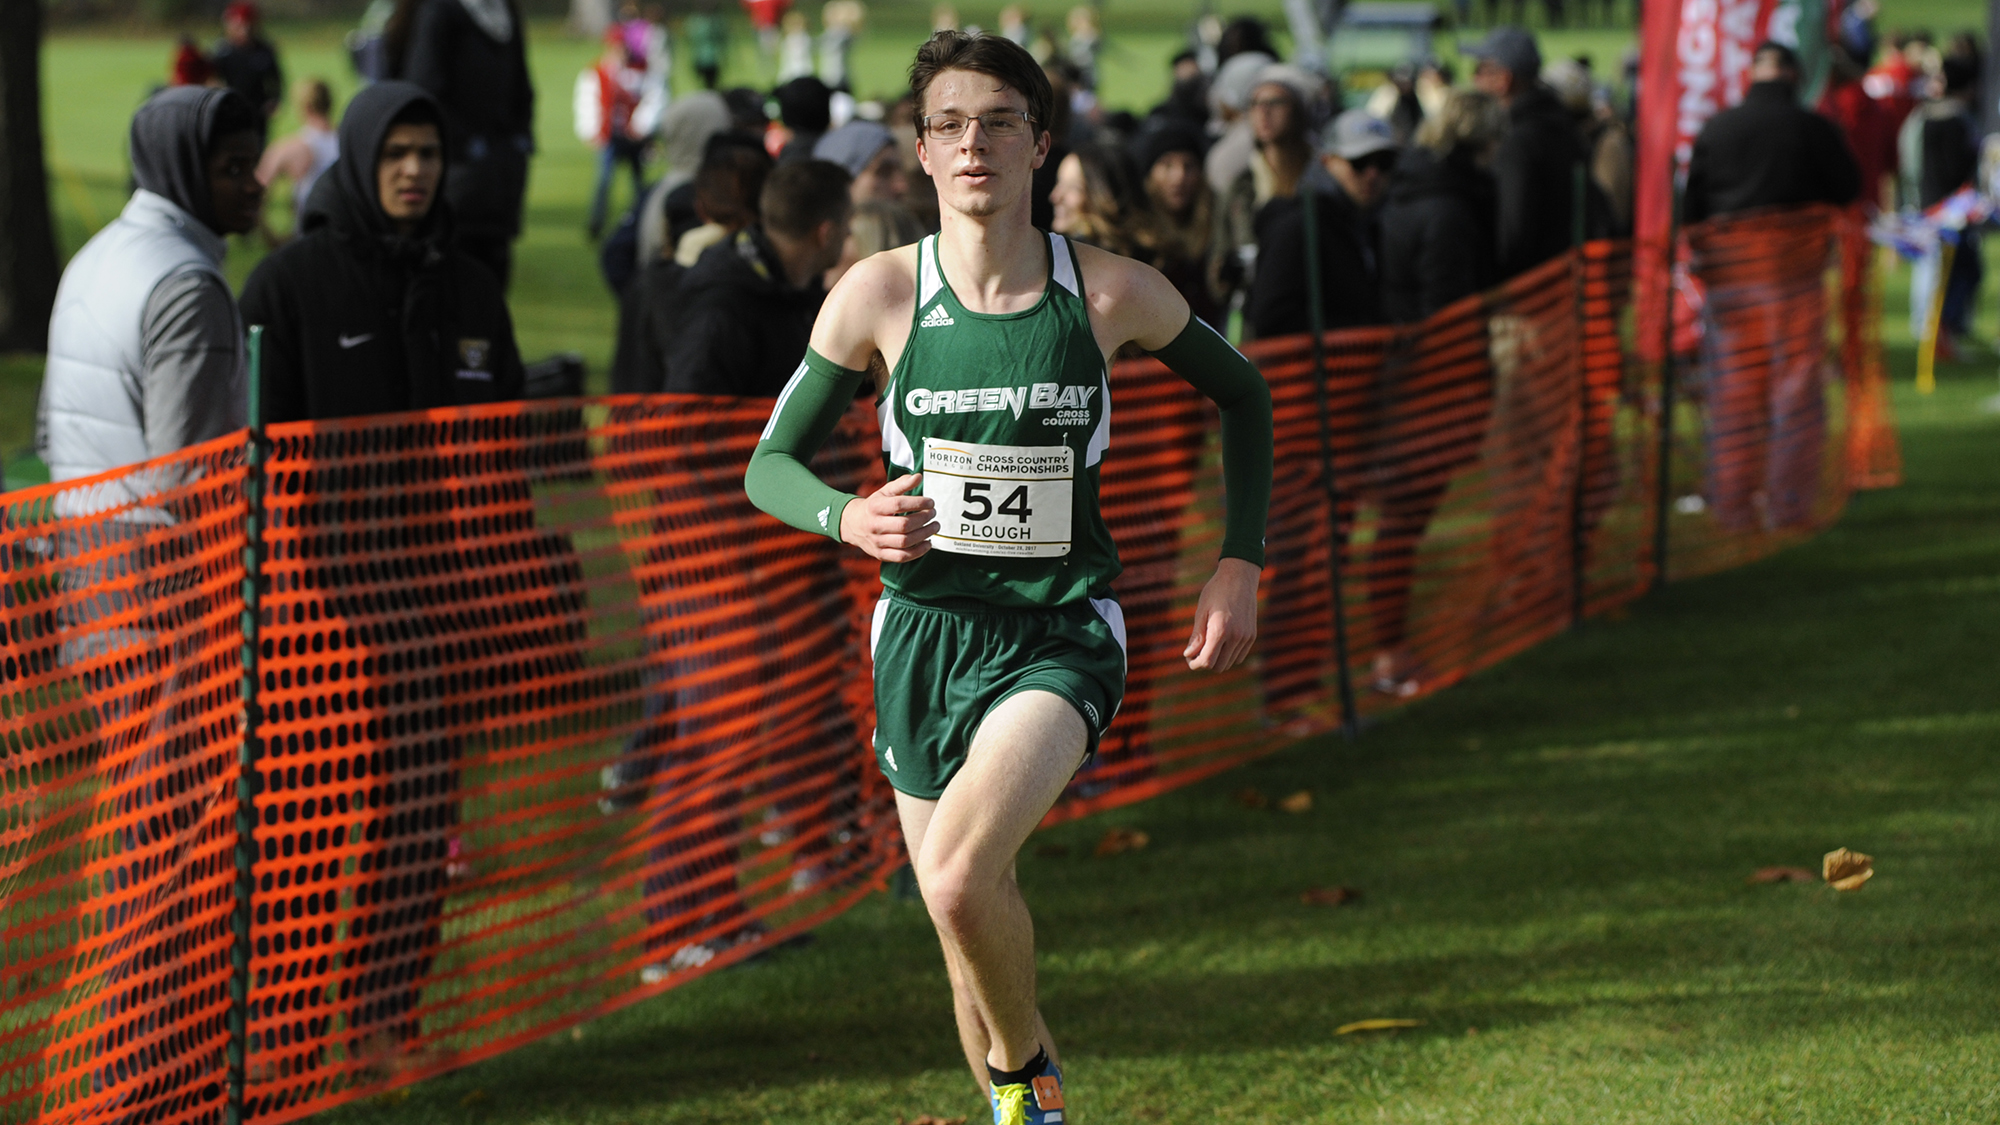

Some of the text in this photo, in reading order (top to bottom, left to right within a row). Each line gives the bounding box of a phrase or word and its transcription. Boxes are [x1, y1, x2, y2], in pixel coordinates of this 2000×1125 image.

[921, 316, 955, 328] adidas
[905, 382, 1099, 421] GREEN BAY
[1056, 410, 1090, 419] CROSS
[1042, 417, 1091, 426] COUNTRY
[929, 452, 973, 465] HORIZON
[978, 454, 1068, 464] CROSS COUNTRY
[976, 463, 1069, 474] CHAMPIONSHIPS
[961, 481, 1032, 524] 54
[960, 523, 1031, 540] PLOUGH
